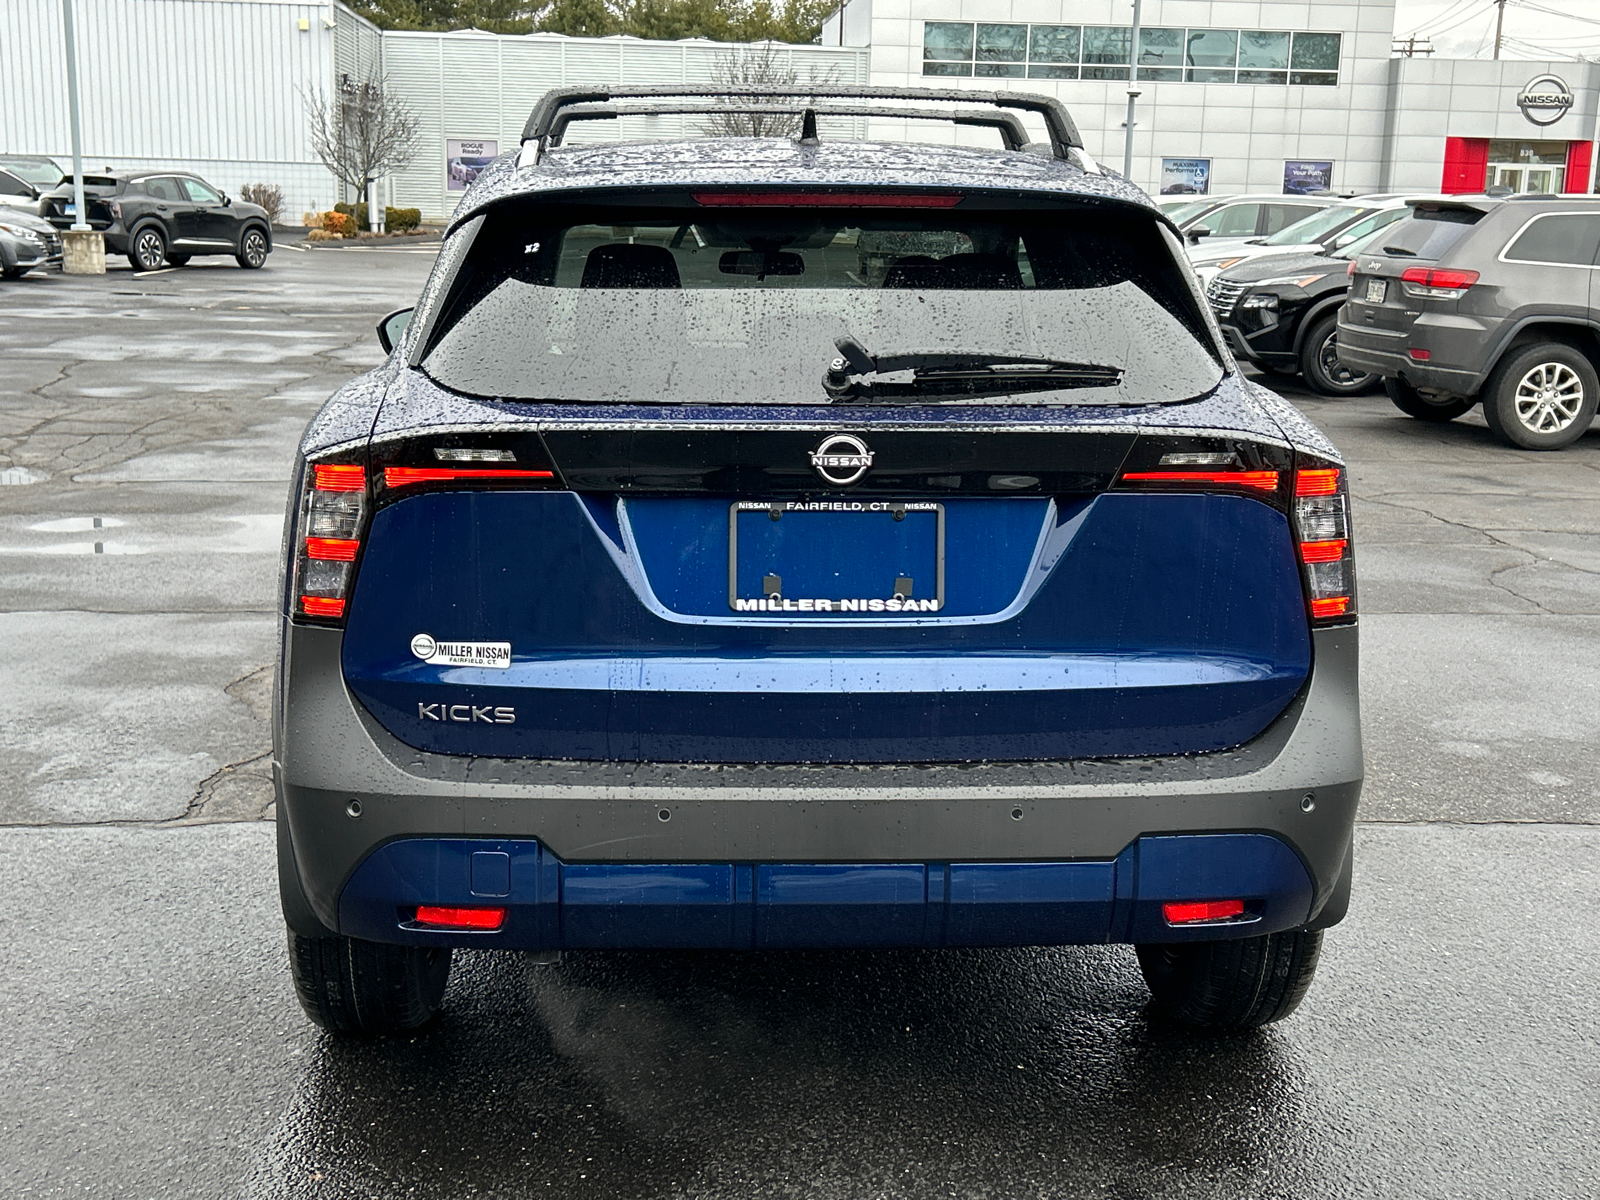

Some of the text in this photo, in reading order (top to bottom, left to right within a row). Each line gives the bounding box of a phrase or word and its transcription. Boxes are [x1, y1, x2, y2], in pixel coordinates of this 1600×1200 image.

[1523, 95, 1570, 105] NISSAN
[812, 457, 872, 466] NISSAN
[786, 502, 890, 512] FAIRFIELD, CT
[736, 599, 939, 612] MILLER NISSAN
[438, 644, 509, 659] MILLER NISSAN
[418, 702, 516, 724] KICKS
